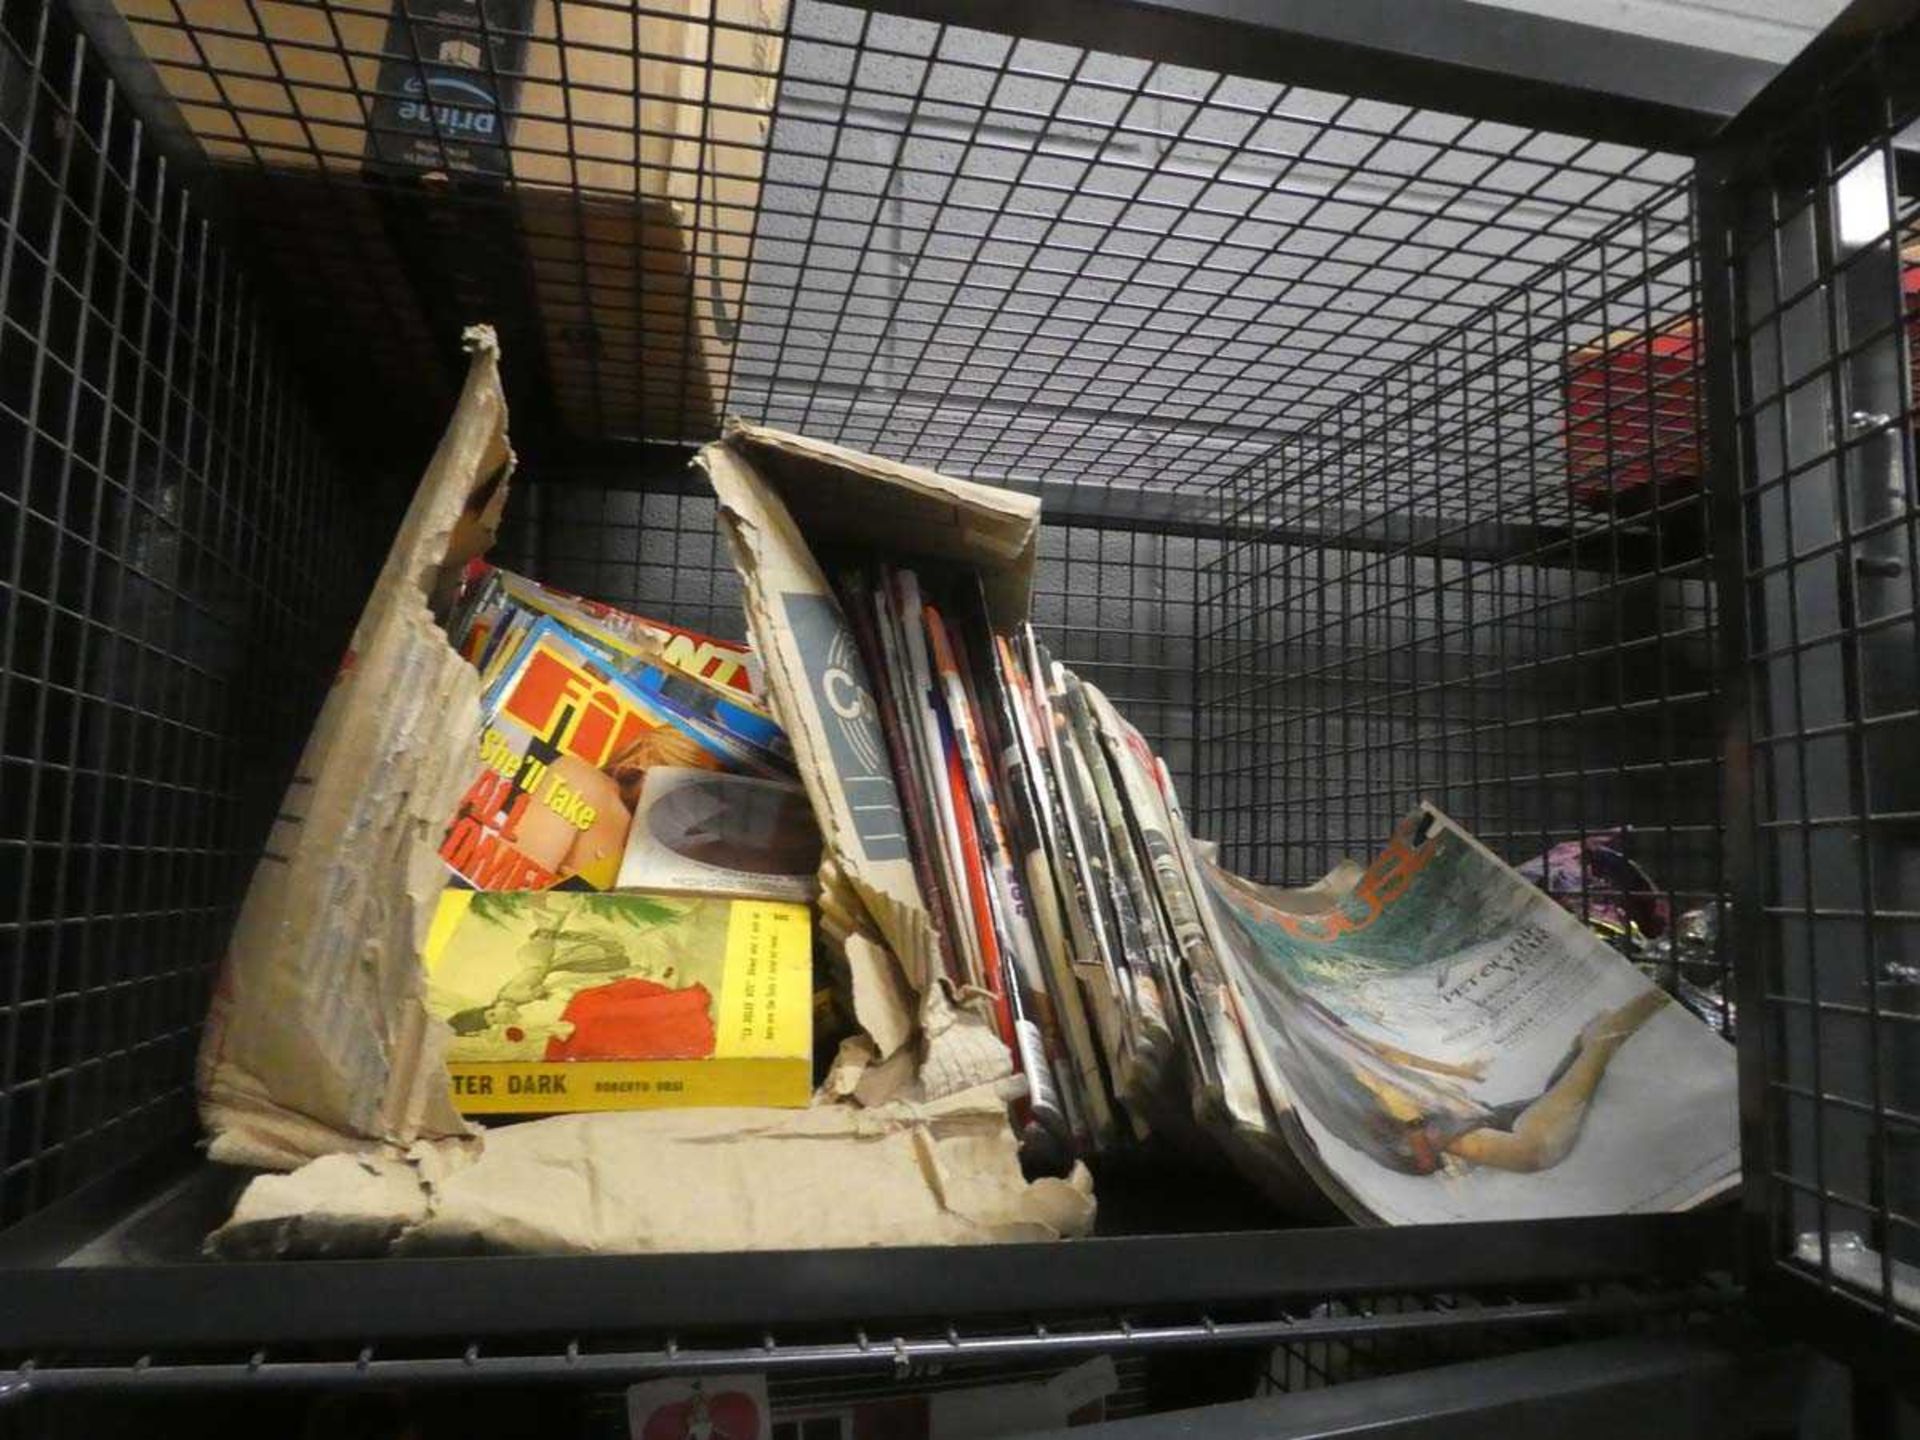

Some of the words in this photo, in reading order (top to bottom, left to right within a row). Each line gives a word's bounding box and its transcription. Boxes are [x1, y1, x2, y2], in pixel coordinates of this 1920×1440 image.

[458, 767, 531, 842] ALL
[544, 773, 597, 832] Take
[507, 1074, 567, 1094] DARK
